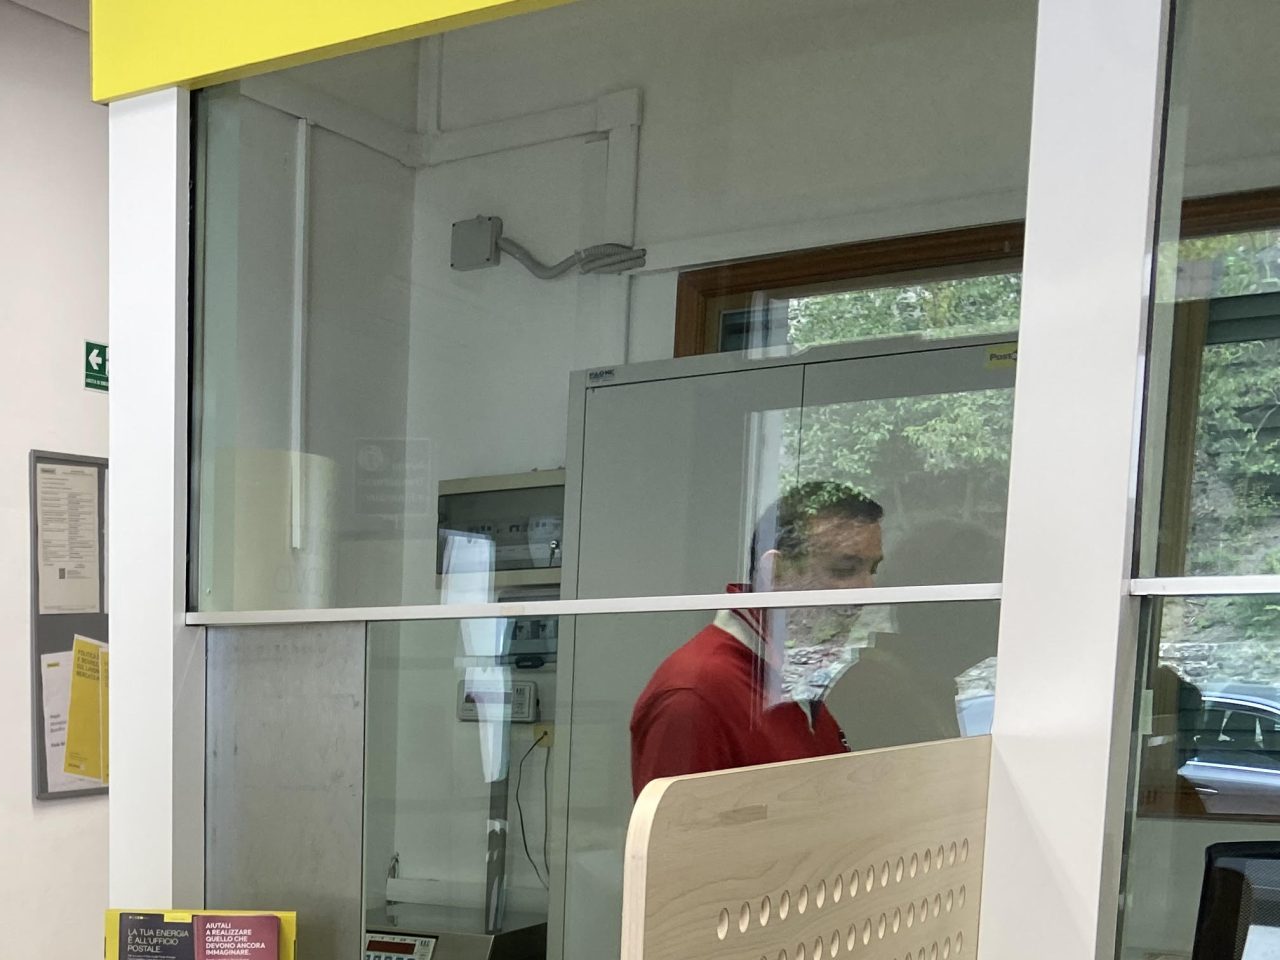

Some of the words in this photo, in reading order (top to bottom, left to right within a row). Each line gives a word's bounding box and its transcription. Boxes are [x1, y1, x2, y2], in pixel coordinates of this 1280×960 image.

[128, 928, 138, 936] LA
[140, 928, 154, 936] TUA
[156, 929, 190, 938] ENERGIA
